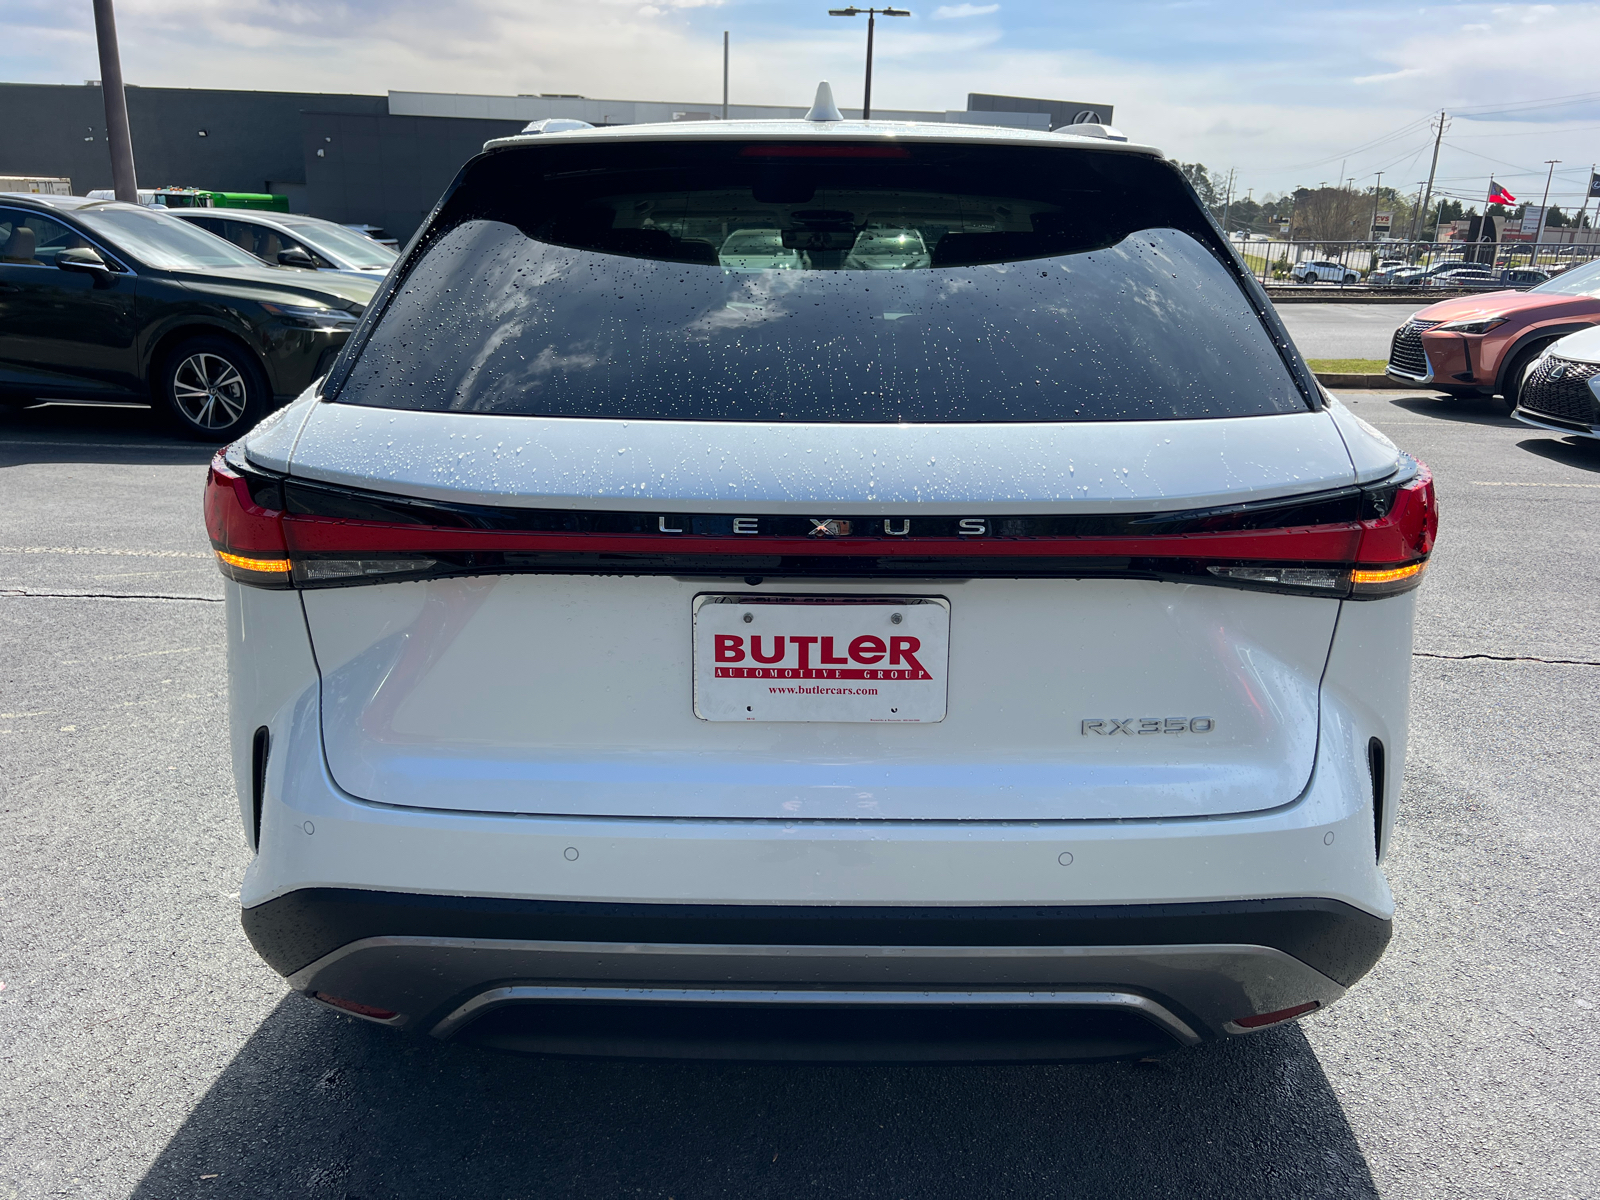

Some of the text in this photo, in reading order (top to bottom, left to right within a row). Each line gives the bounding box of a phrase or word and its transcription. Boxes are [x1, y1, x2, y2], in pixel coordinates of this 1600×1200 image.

[658, 516, 986, 536] LEXUS
[715, 668, 926, 680] AUTOMOTIVE GROUP
[768, 685, 878, 696] www.butlercars.com
